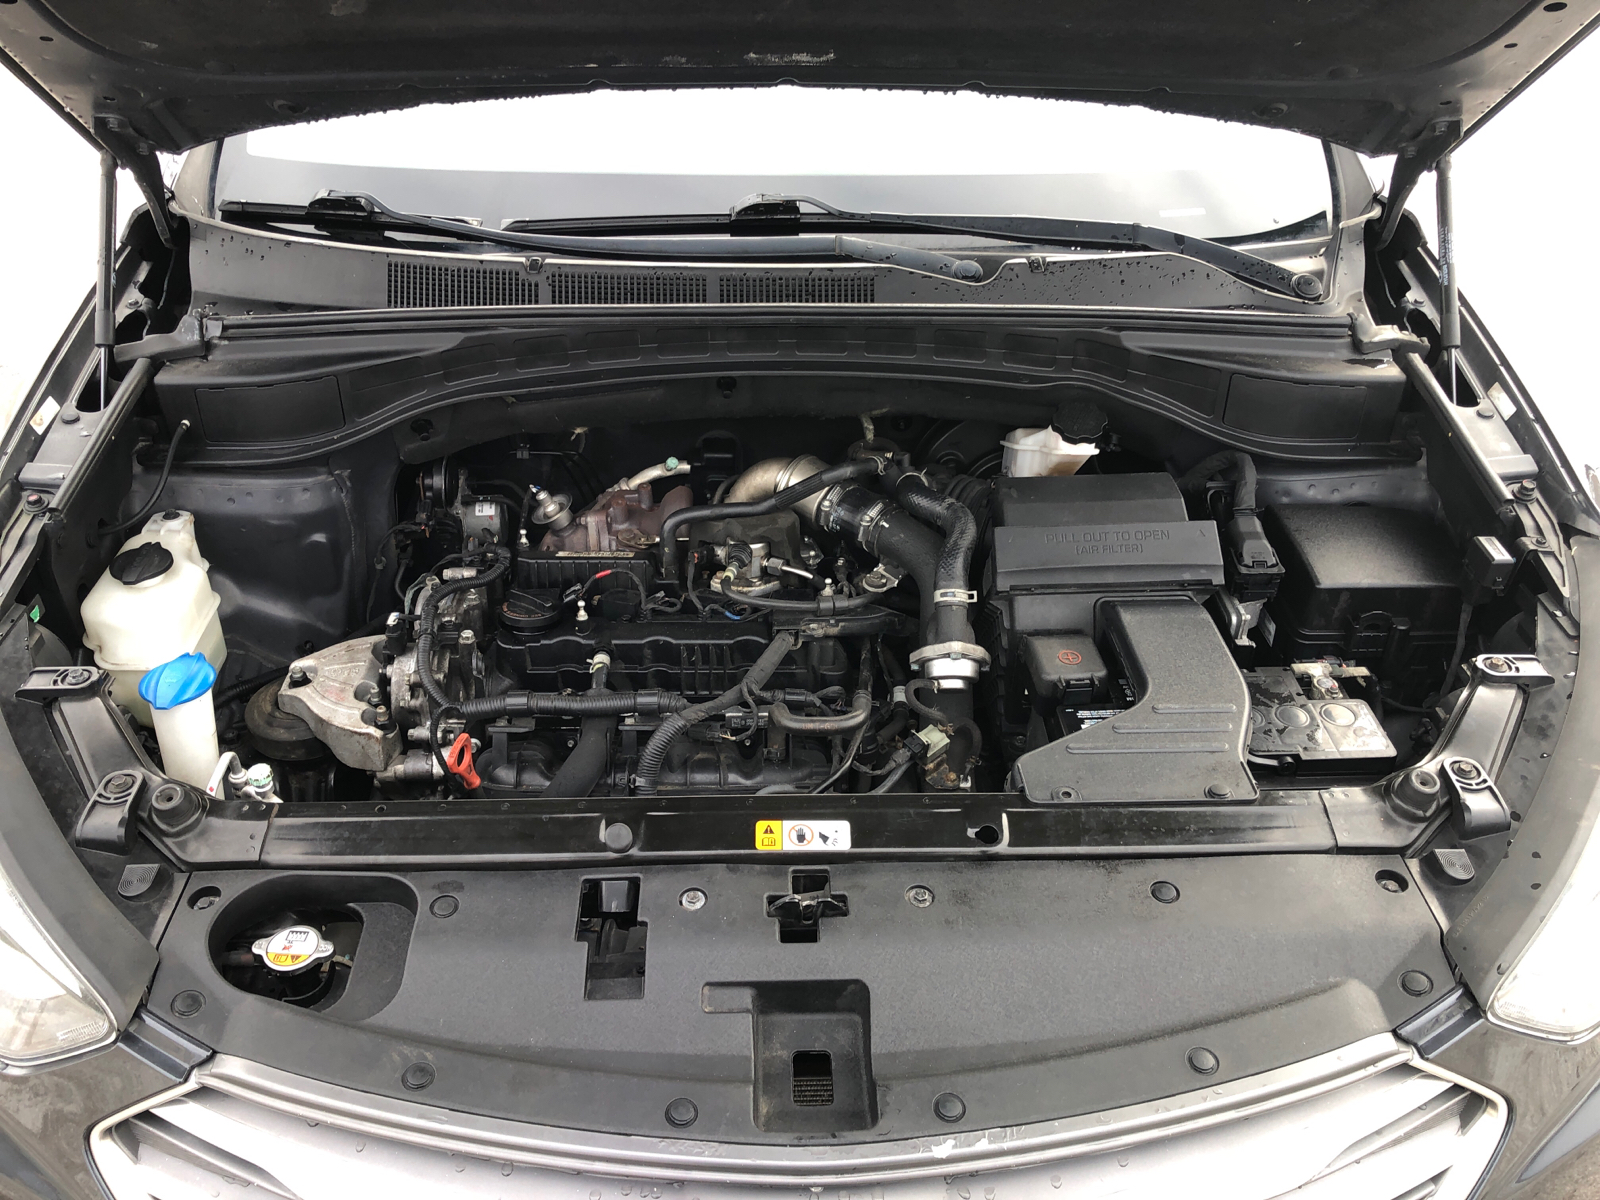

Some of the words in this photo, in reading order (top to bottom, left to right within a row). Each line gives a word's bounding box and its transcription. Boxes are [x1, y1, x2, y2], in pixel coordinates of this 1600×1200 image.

[1045, 533, 1080, 544] PULL
[1083, 531, 1110, 543] OUT
[1113, 530, 1131, 541] TO
[1134, 529, 1170, 541] OPEN
